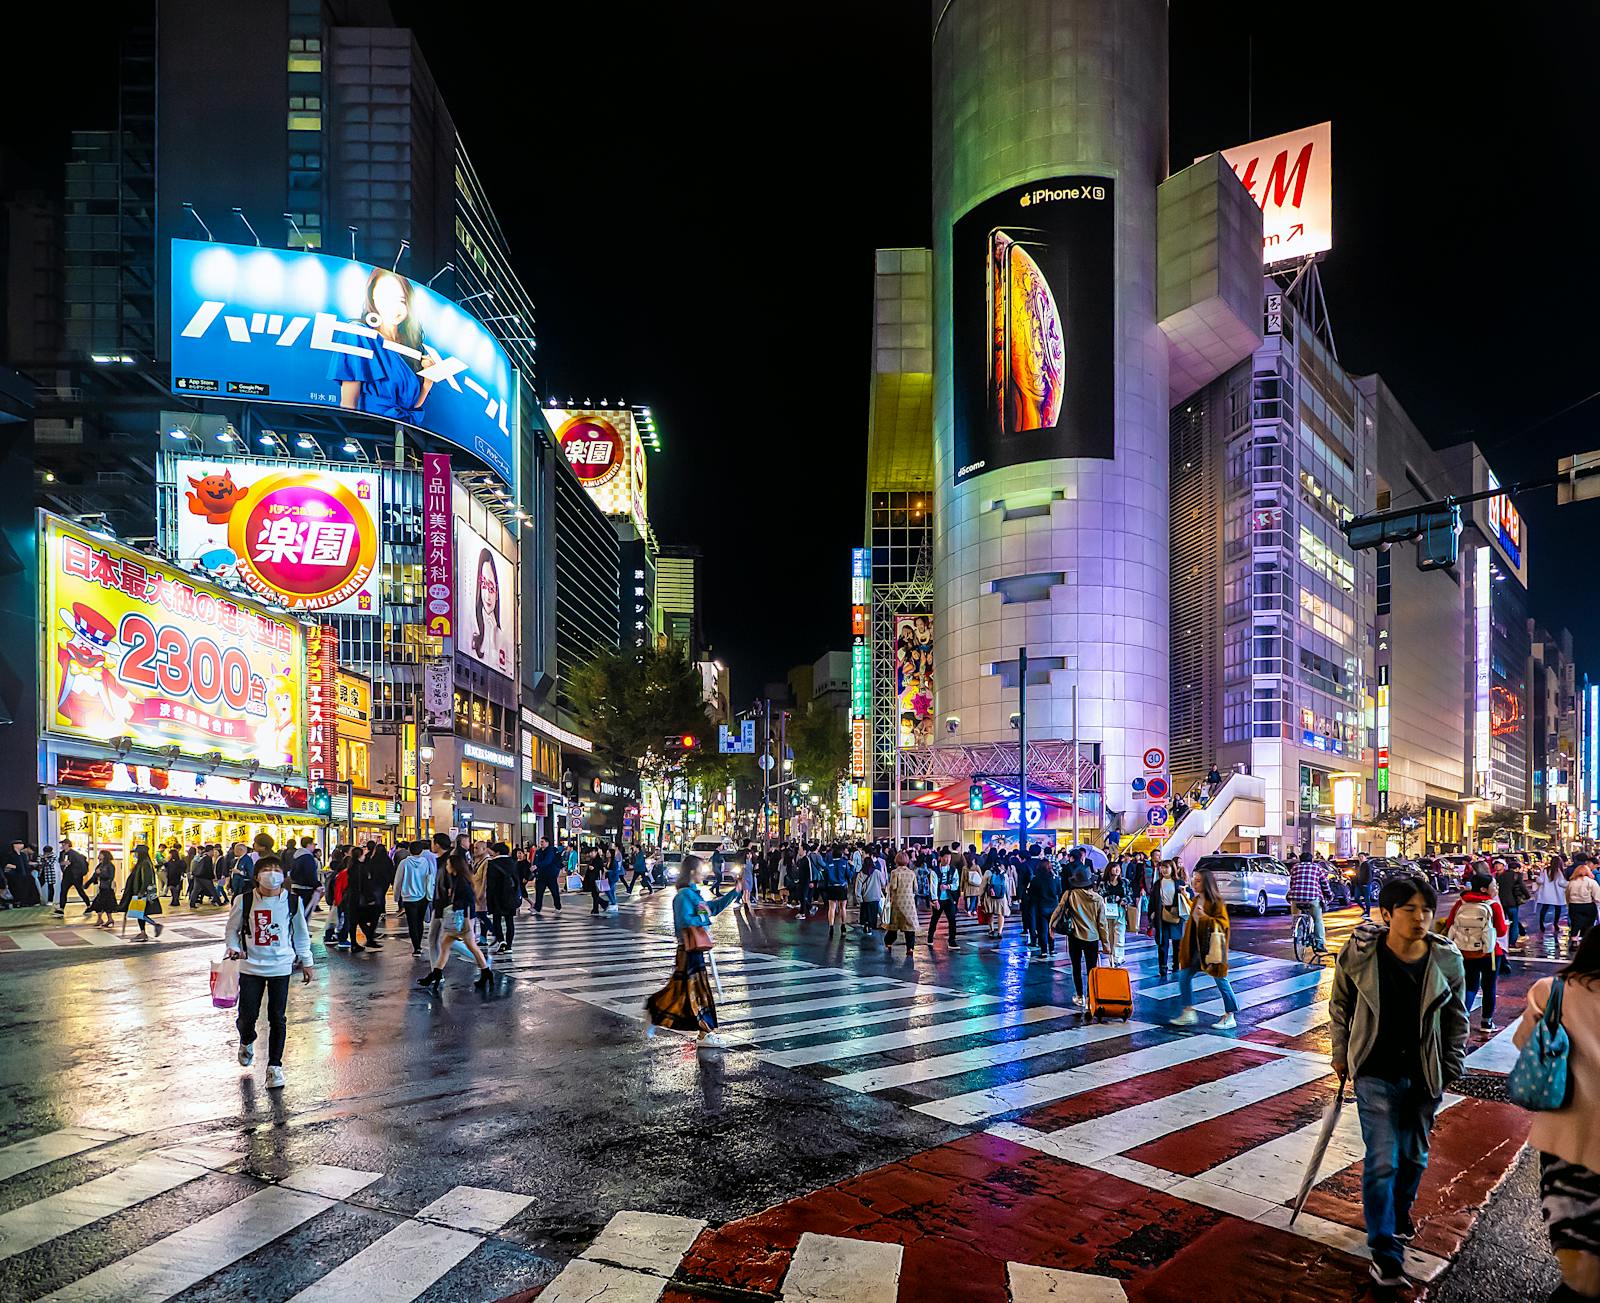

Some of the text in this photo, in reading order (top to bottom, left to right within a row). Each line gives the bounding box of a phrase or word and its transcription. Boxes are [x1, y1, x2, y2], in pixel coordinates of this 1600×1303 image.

[1032, 187, 1079, 204] iPhone
[1268, 297, 1281, 329] 玉久
[181, 300, 509, 437] ハッピーメール
[188, 378, 199, 386] App
[238, 383, 254, 391] Google
[565, 440, 613, 465] 楽園
[958, 459, 985, 477] docomo
[253, 516, 356, 567] 楽園
[429, 477, 449, 583] 品川美容外科
[62, 535, 292, 655] 日本最大級の超大型店
[295, 564, 371, 609] AMUSEMENT
[310, 626, 322, 682] パチンコ
[310, 685, 323, 764] エスパス
[853, 724, 863, 772] HOOTERS
[1148, 753, 1161, 764] 30
[422, 785, 428, 793] 3
[1151, 811, 1160, 824] P
